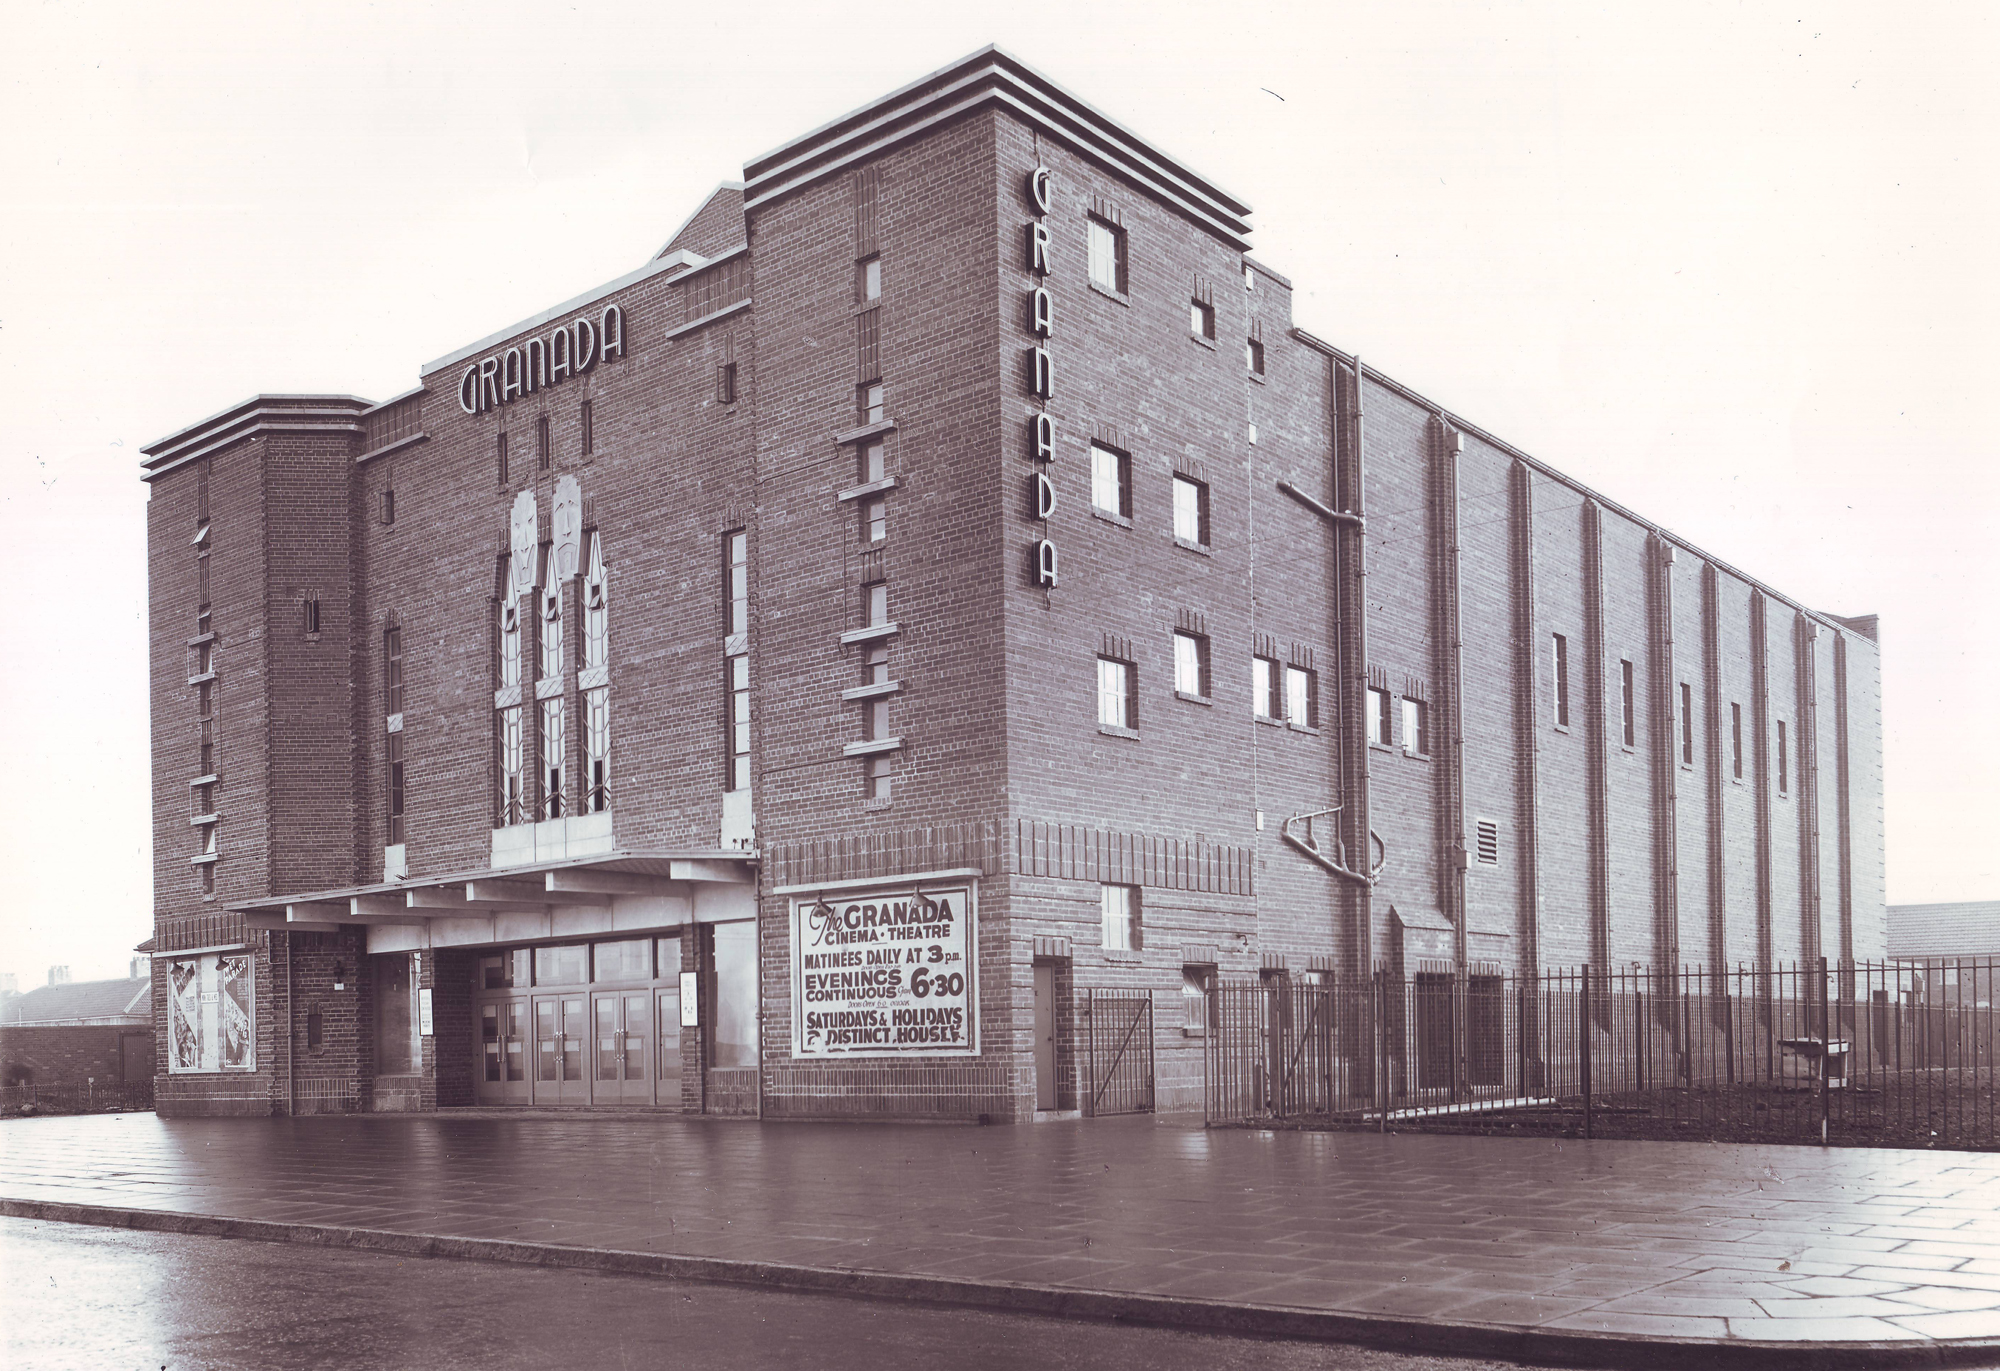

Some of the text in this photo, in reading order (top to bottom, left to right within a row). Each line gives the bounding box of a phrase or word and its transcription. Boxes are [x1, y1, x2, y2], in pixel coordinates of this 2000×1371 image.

[458, 304, 623, 414] GRANADA
[1031, 167, 1058, 587] GRANADA
[809, 898, 954, 946] The GRANADA
[825, 924, 950, 945] CINEMA THEATRE
[805, 951, 863, 969] MATINEES
[867, 948, 902, 965] DAILY
[906, 948, 922, 963] AT
[927, 945, 944, 963] 3
[225, 960, 247, 985] PARADE
[805, 969, 902, 990] EVENINGS
[806, 986, 897, 1002] CONTINUOUS
[807, 1007, 962, 1029] SATURDAYS & HOLIDAYS
[825, 1027, 891, 1046] DISTINCT
